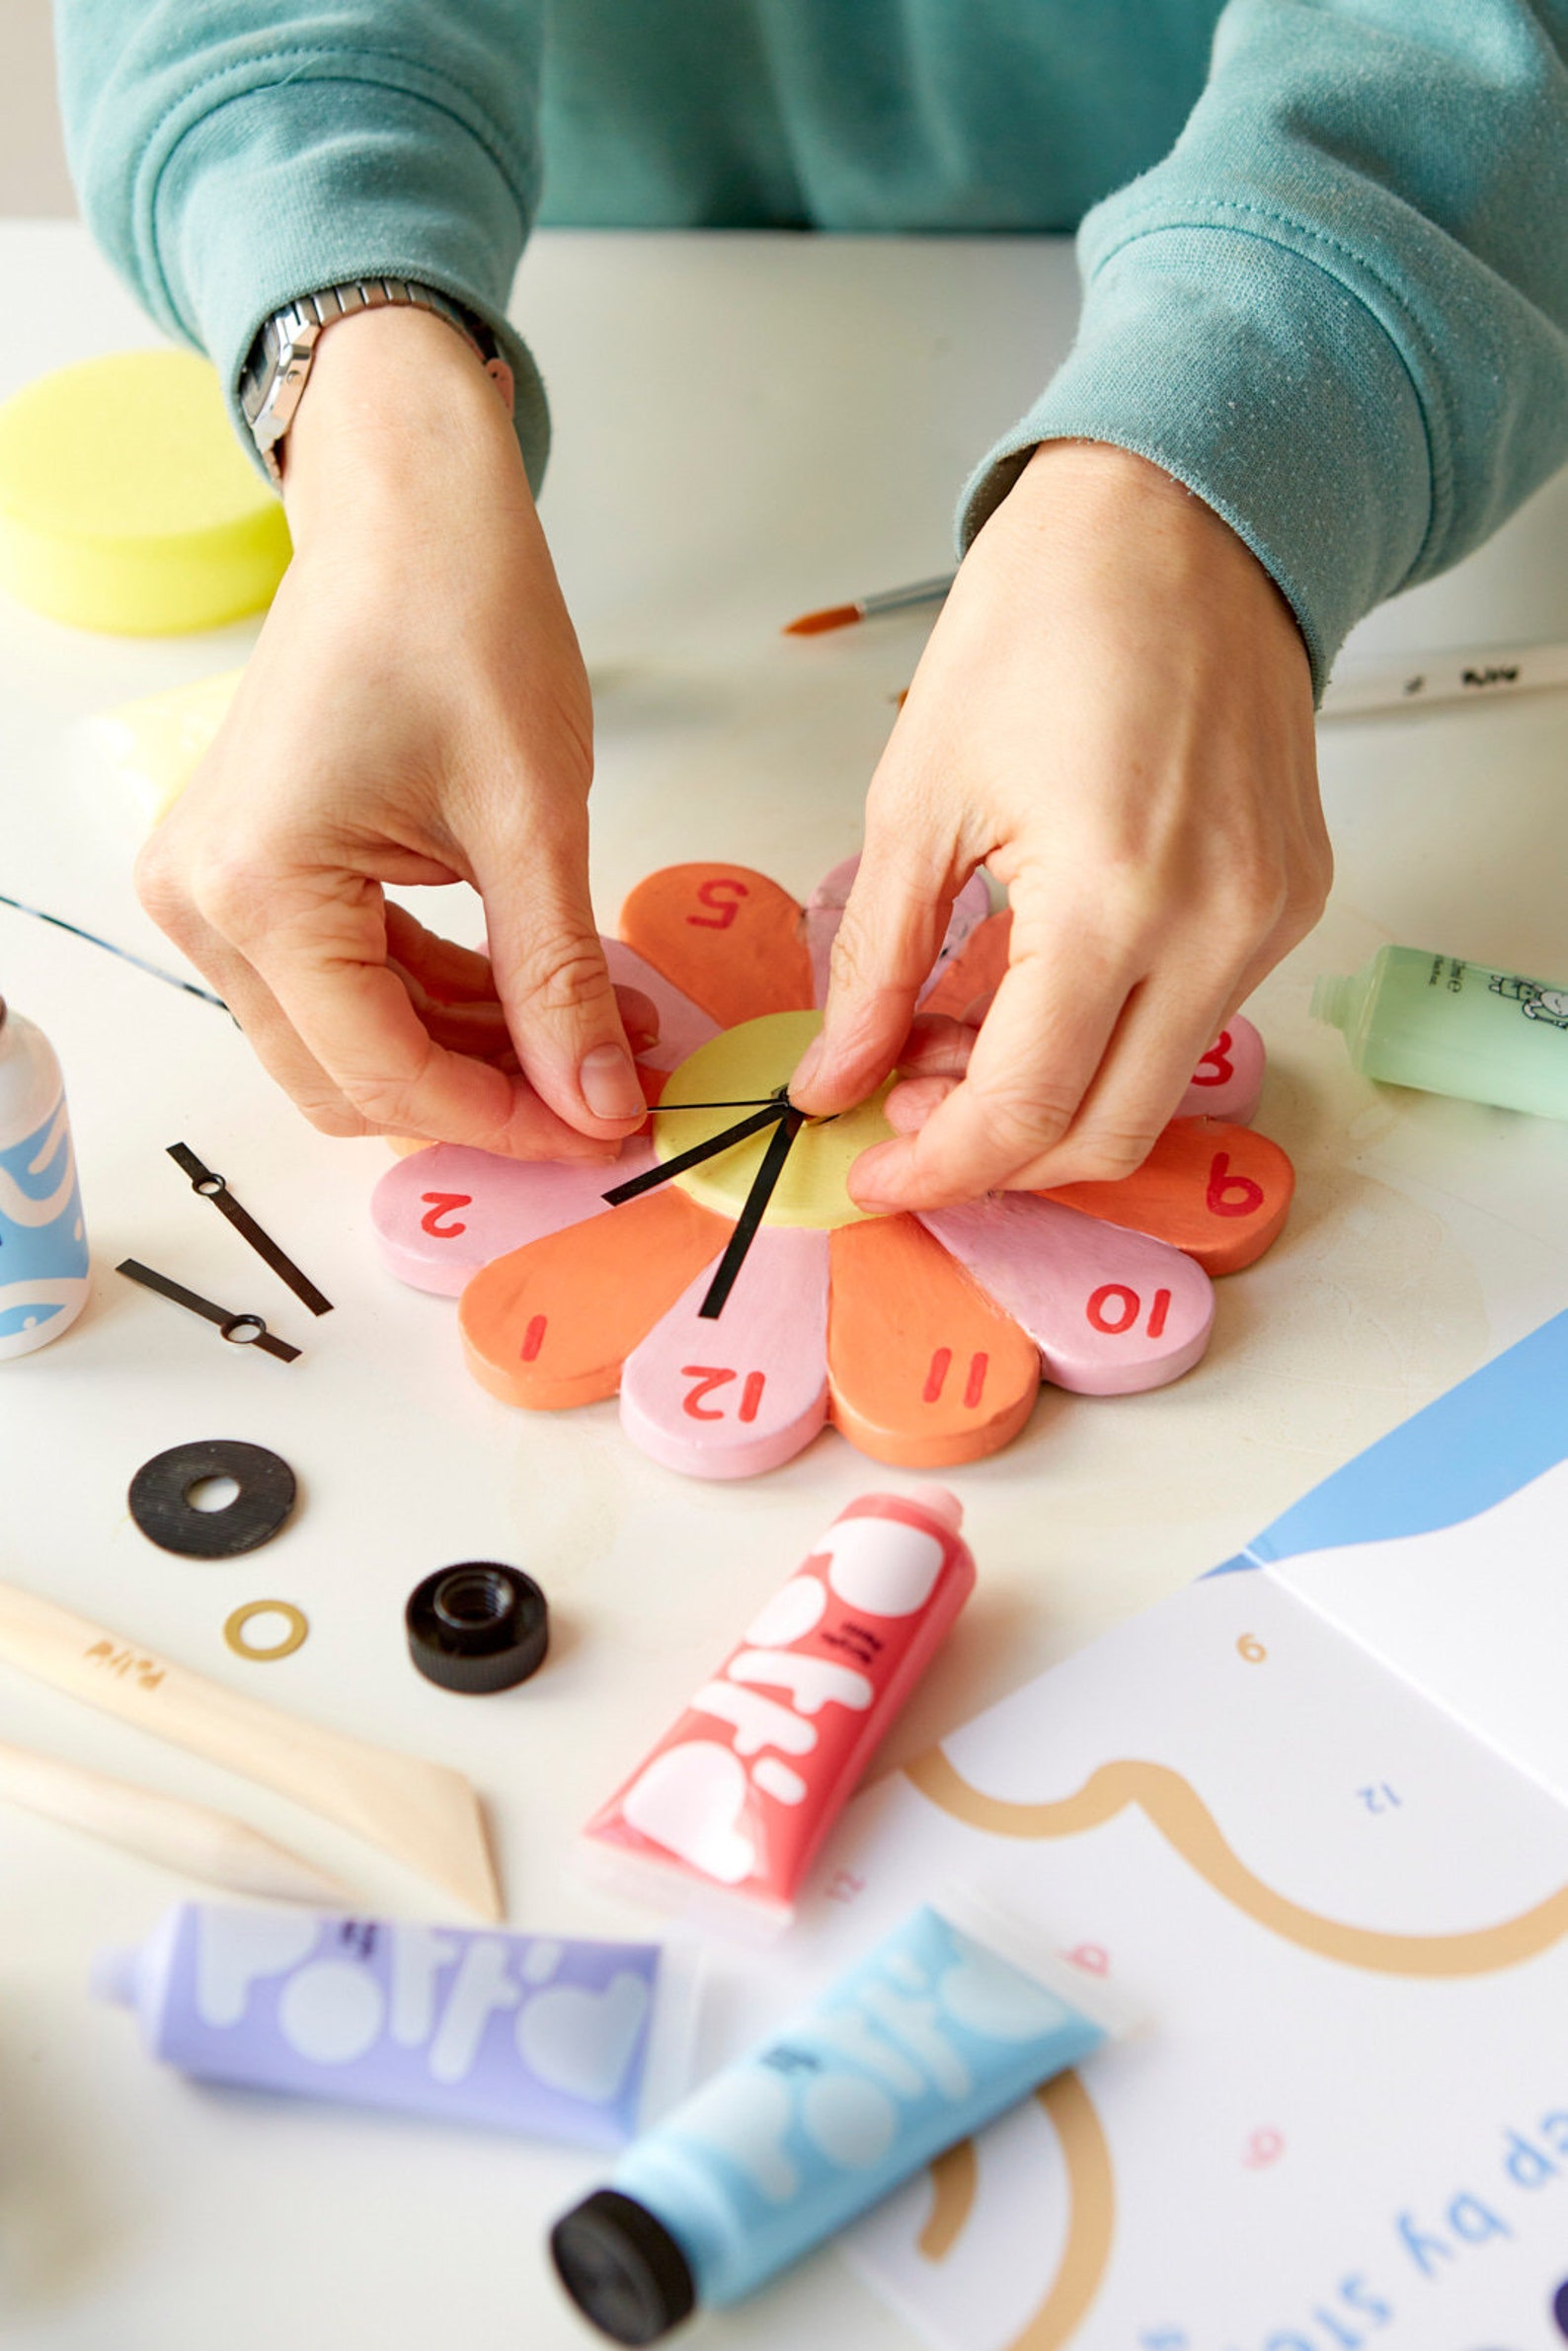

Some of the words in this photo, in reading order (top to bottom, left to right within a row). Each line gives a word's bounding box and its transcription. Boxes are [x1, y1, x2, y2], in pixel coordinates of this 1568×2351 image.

[686, 879, 749, 931] 5
[1206, 1151, 1264, 1216] 9
[422, 1191, 473, 1238] 2
[520, 1314, 548, 1363] 1
[1087, 1284, 1172, 1339] 10
[680, 1365, 766, 1424] 12
[922, 1346, 990, 1409] 11
[1357, 1782, 1403, 1815] 12
[1393, 2189, 1513, 2279] by
